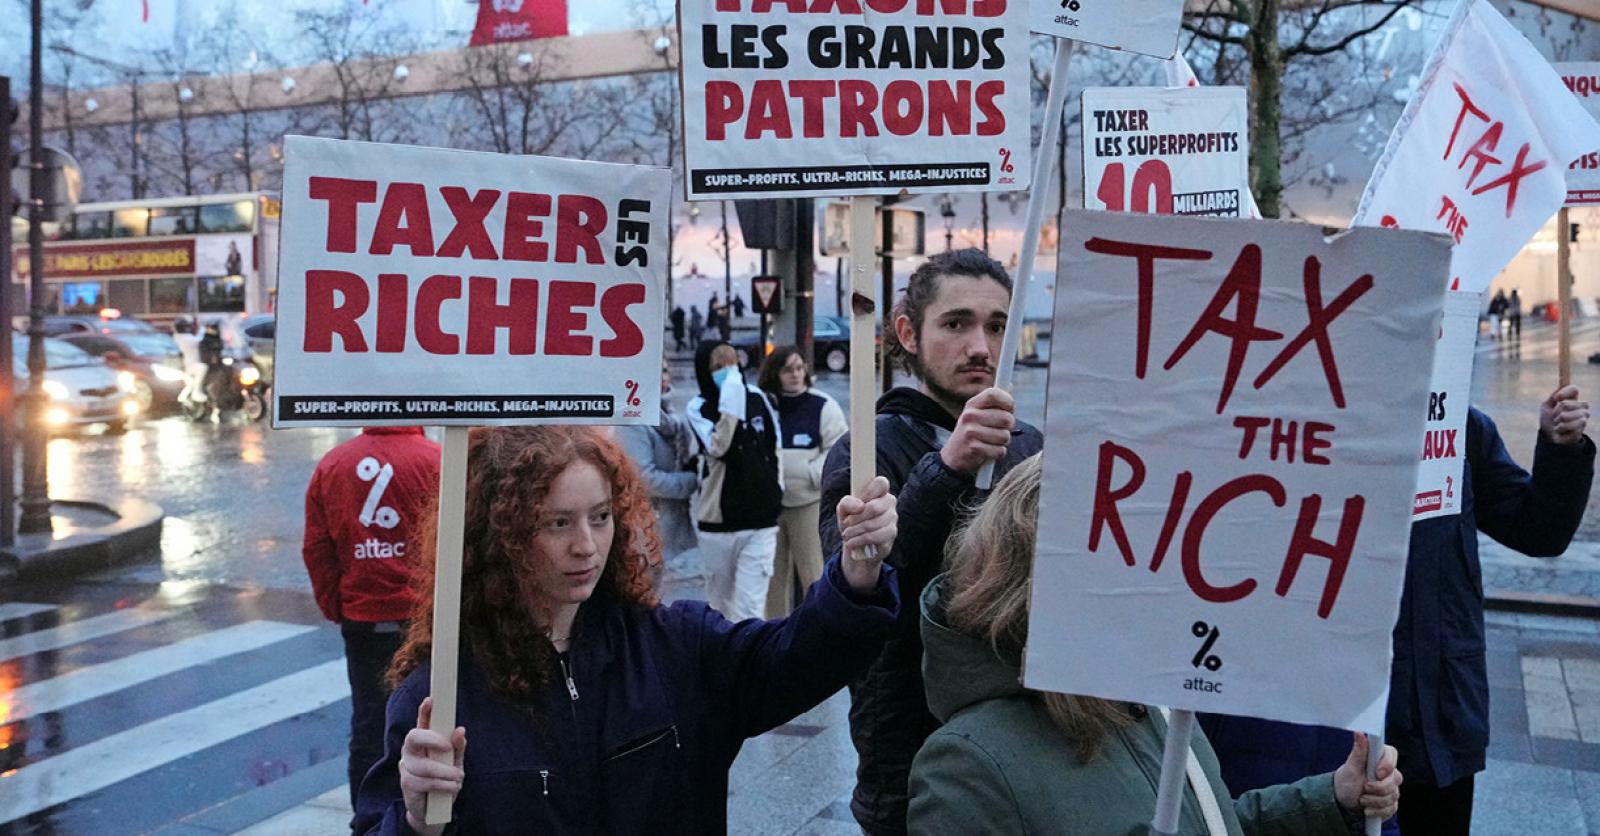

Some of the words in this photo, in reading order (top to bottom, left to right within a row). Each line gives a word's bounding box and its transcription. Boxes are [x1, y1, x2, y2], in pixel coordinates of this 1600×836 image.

[1054, 15, 1080, 27] attac
[702, 24, 789, 69] LES
[807, 25, 1005, 70] GRANDS
[705, 79, 1006, 141] PATRONS
[1094, 110, 1148, 132] TAXER
[1095, 136, 1123, 157] LES
[1127, 132, 1239, 157] SUPERPROFITS
[1443, 82, 1547, 218] TAX
[705, 172, 800, 186] SUPER-PROFITS,
[802, 170, 887, 183] ULTRA-RICHES,
[889, 168, 987, 180] MEGA-INJUSTICES
[309, 176, 609, 265] TAXER
[1173, 191, 1237, 213] MILLIARDS
[614, 198, 651, 267] LES
[303, 269, 646, 358] RICHES
[1085, 236, 1374, 415] TAX
[294, 401, 402, 414] SUPER-PROFITS,
[406, 400, 499, 413] ULTRA-RICHES,
[503, 400, 610, 412] MEGA-INJUSTICES
[1233, 416, 1336, 465] THE
[354, 538, 405, 559] attac
[1088, 439, 1365, 619] RICH
[1182, 677, 1223, 693] attac
